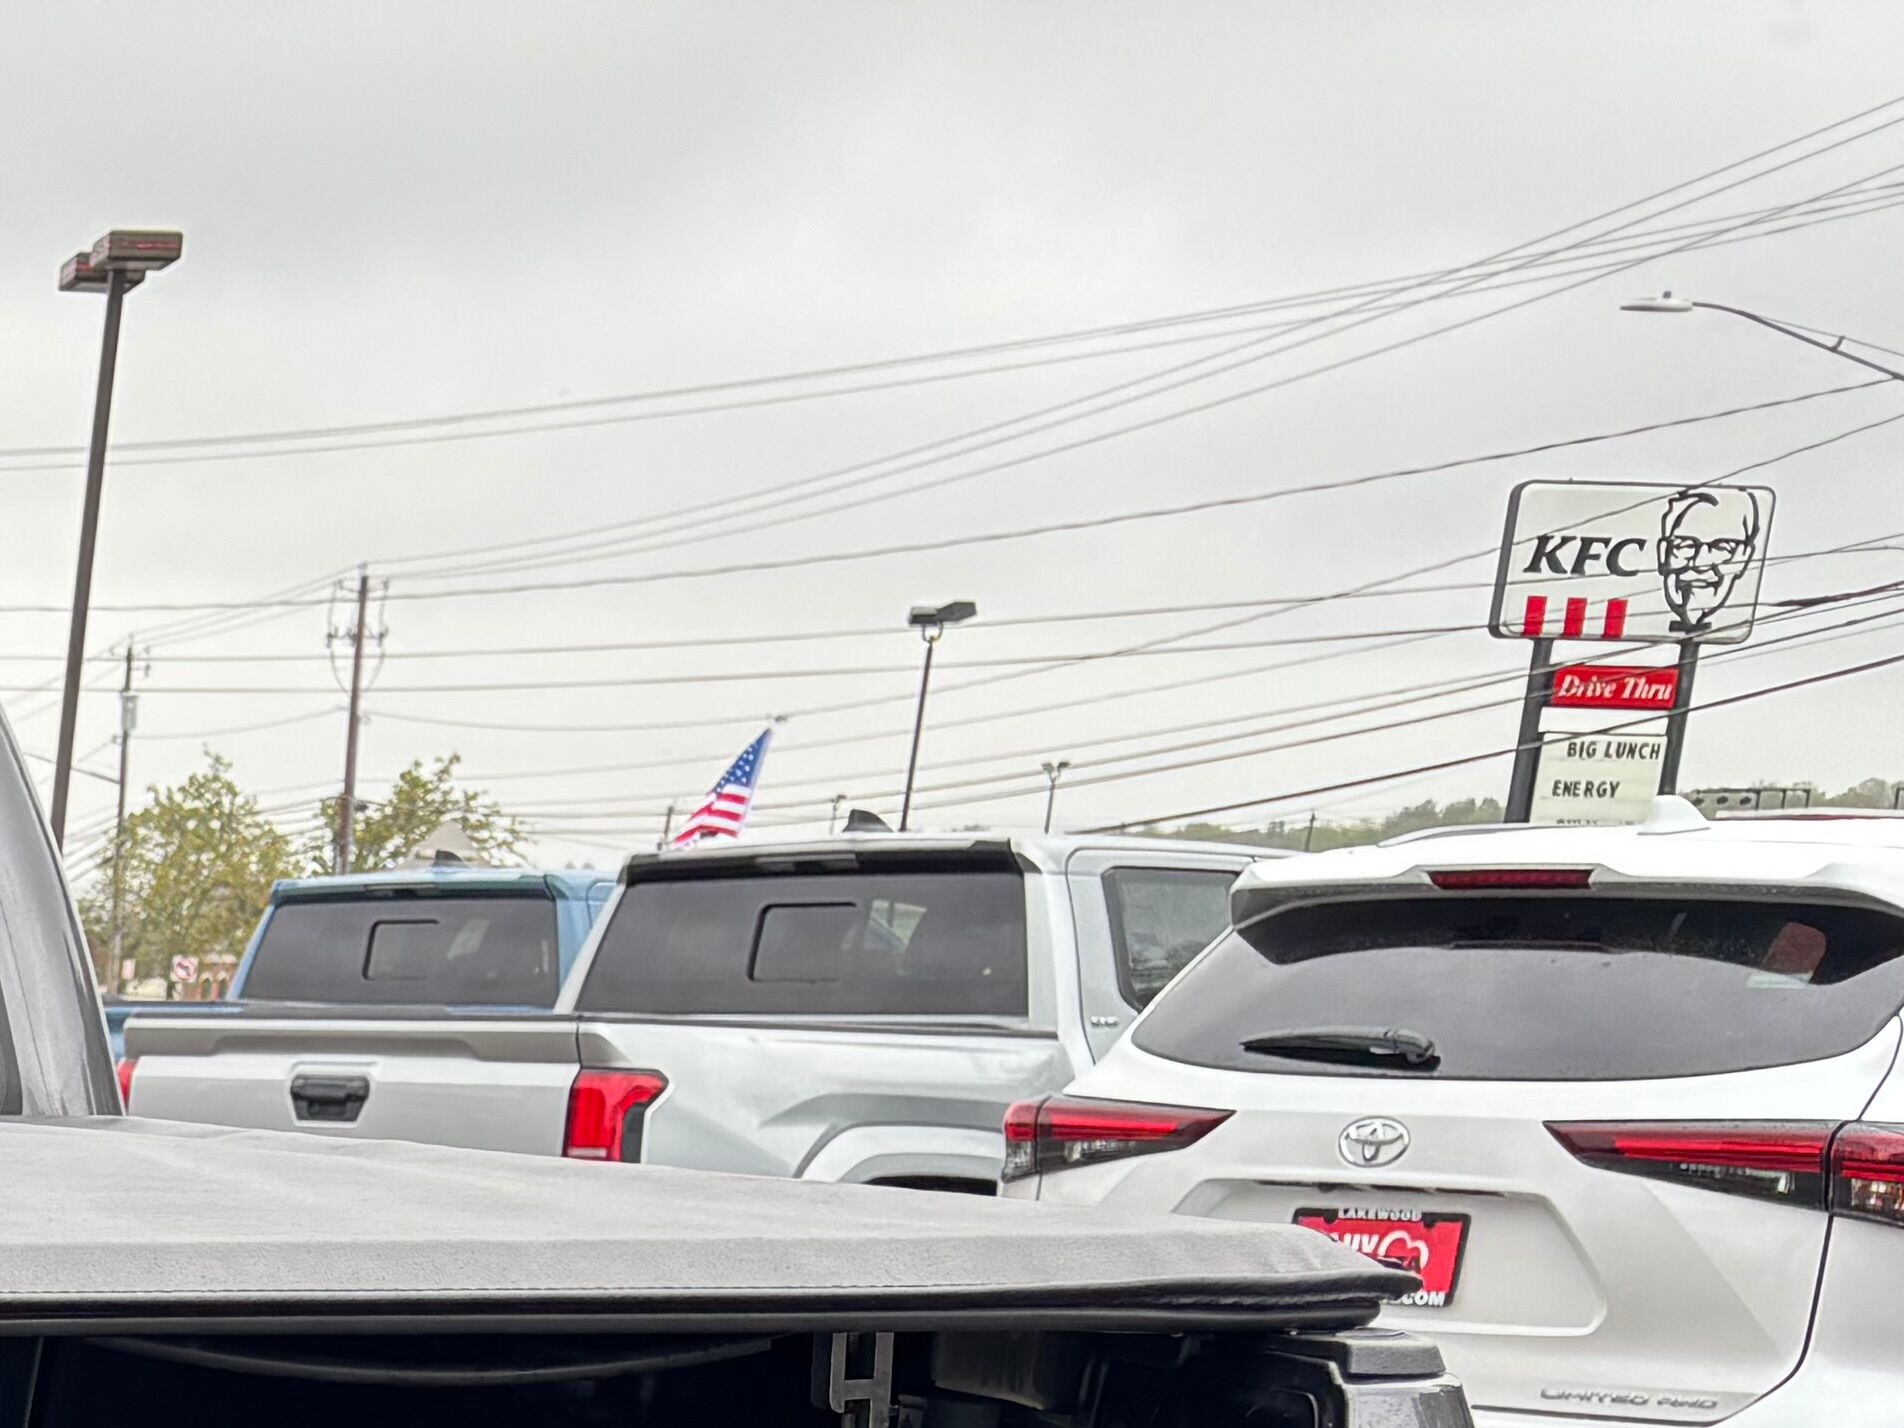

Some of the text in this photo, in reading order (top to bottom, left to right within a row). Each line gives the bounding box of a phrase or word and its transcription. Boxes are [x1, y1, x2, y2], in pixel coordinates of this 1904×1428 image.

[1523, 535, 1647, 577] KFC
[1558, 675, 1675, 700] Drive Thru
[1567, 741, 1660, 760] BIG LUNCH
[1552, 779, 1620, 799] ENERGY
[1338, 1207, 1423, 1222] LAKEWOOD
